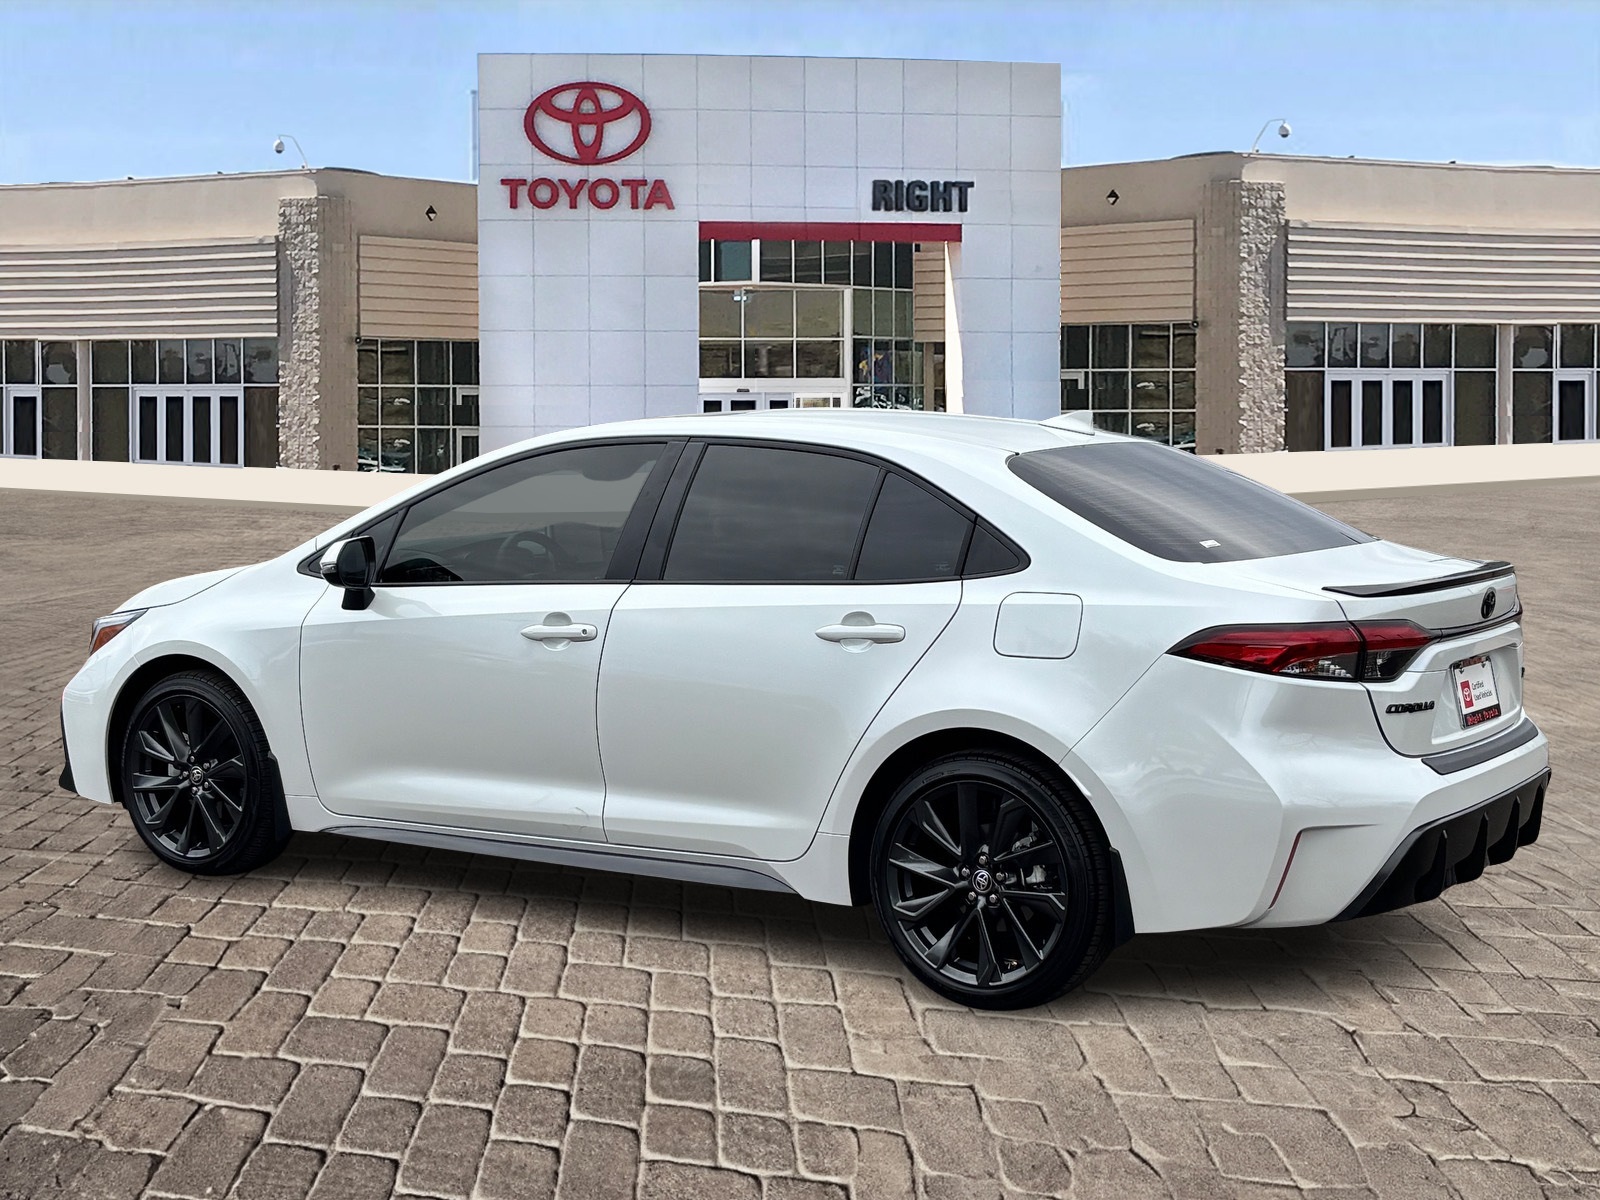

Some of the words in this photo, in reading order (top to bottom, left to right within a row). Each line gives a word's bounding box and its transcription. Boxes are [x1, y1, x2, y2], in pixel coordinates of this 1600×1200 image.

[500, 177, 676, 210] TOYOTA
[871, 179, 975, 213] RIGHT
[1385, 700, 1435, 713] COROLLA
